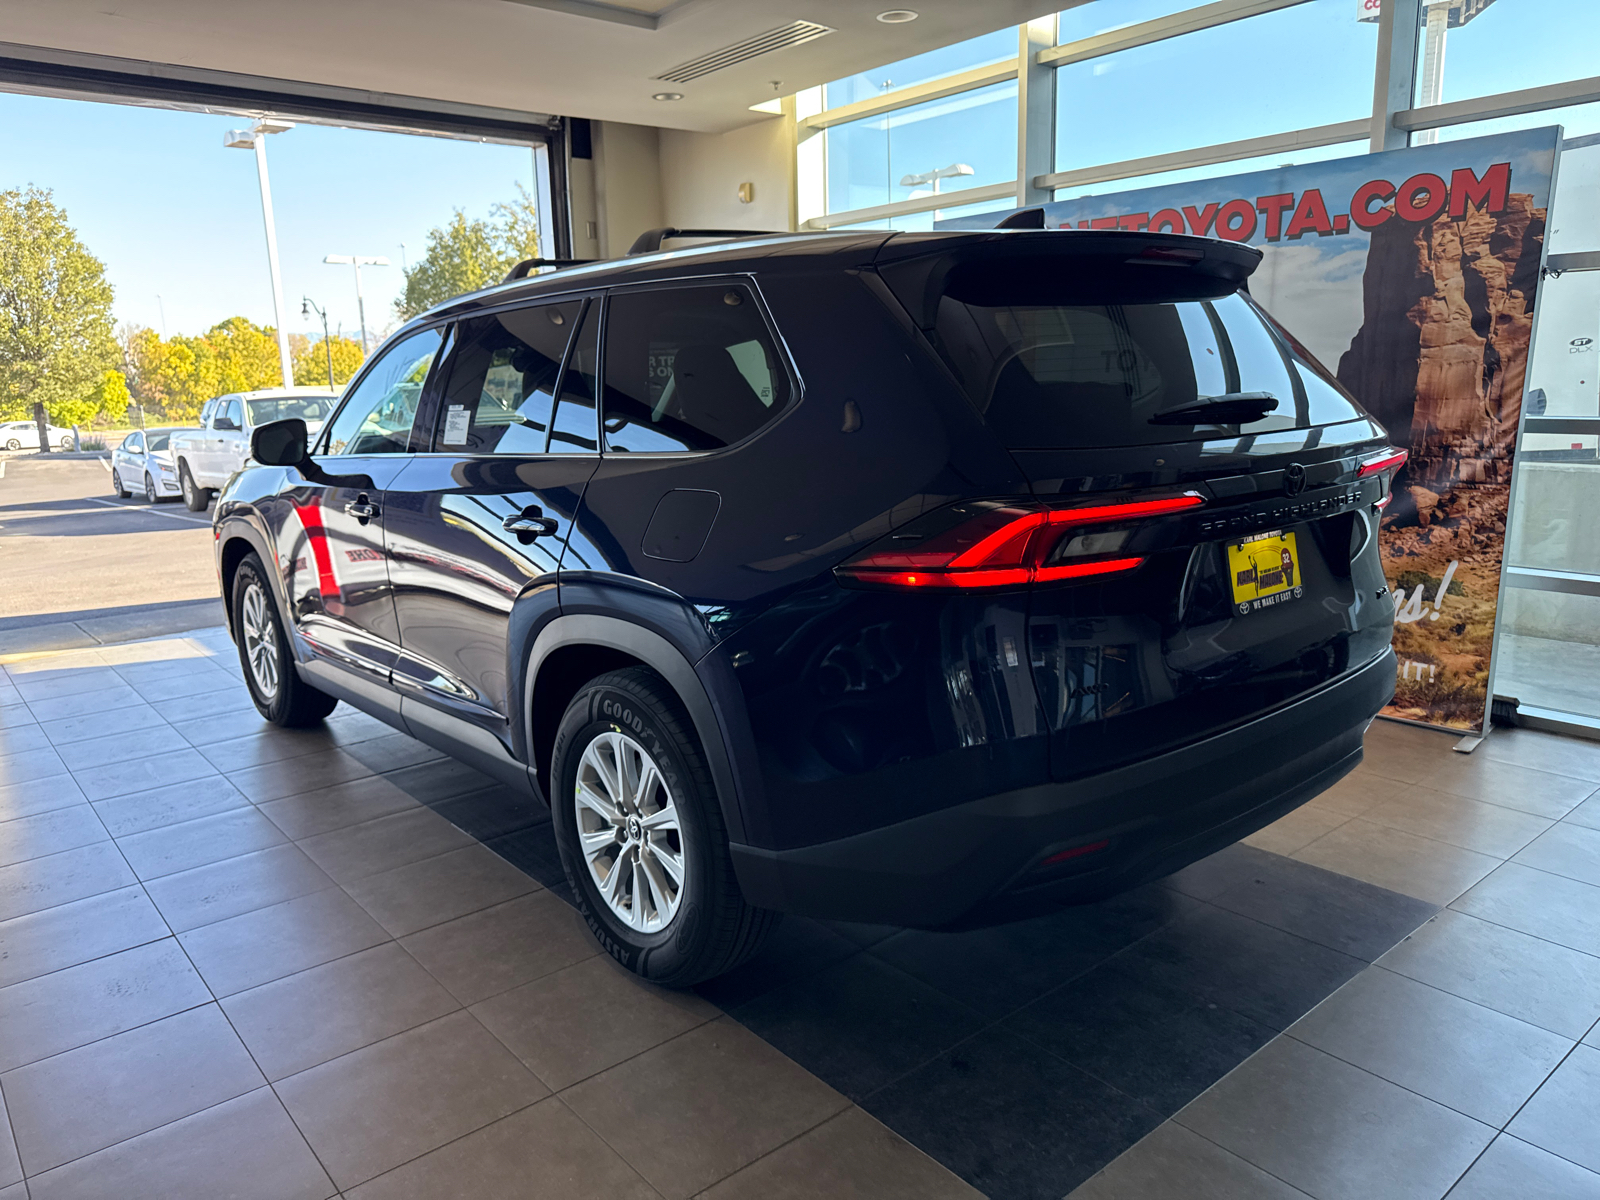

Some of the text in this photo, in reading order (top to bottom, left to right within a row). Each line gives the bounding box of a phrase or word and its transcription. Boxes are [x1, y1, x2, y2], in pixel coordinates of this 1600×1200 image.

[1569, 345, 1593, 354] DLX
[1273, 492, 1362, 517] HIGHLANDER
[1283, 553, 1290, 563] 32
[1253, 601, 1262, 610] WE
[1261, 596, 1276, 607] MAKE
[1280, 591, 1292, 602] EASY
[603, 699, 685, 806] GOODYEAR
